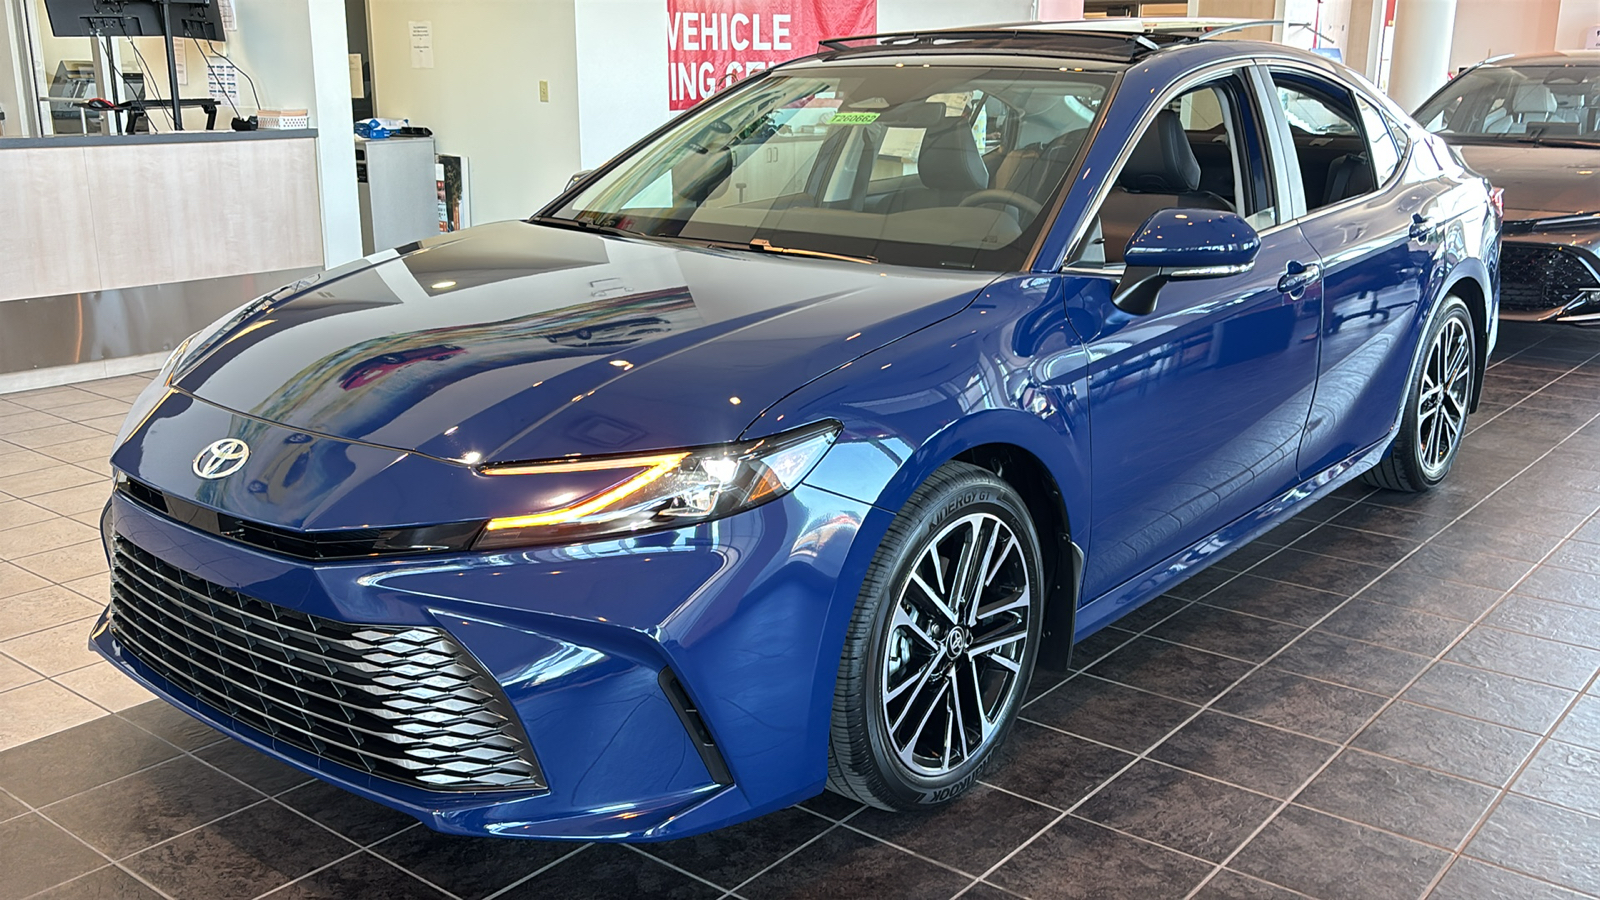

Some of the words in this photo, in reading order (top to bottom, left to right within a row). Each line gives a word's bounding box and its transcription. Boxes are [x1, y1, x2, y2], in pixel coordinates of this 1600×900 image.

[667, 12, 792, 51] VEHICLE
[928, 491, 976, 531] KINERGY
[979, 490, 991, 501] GT
